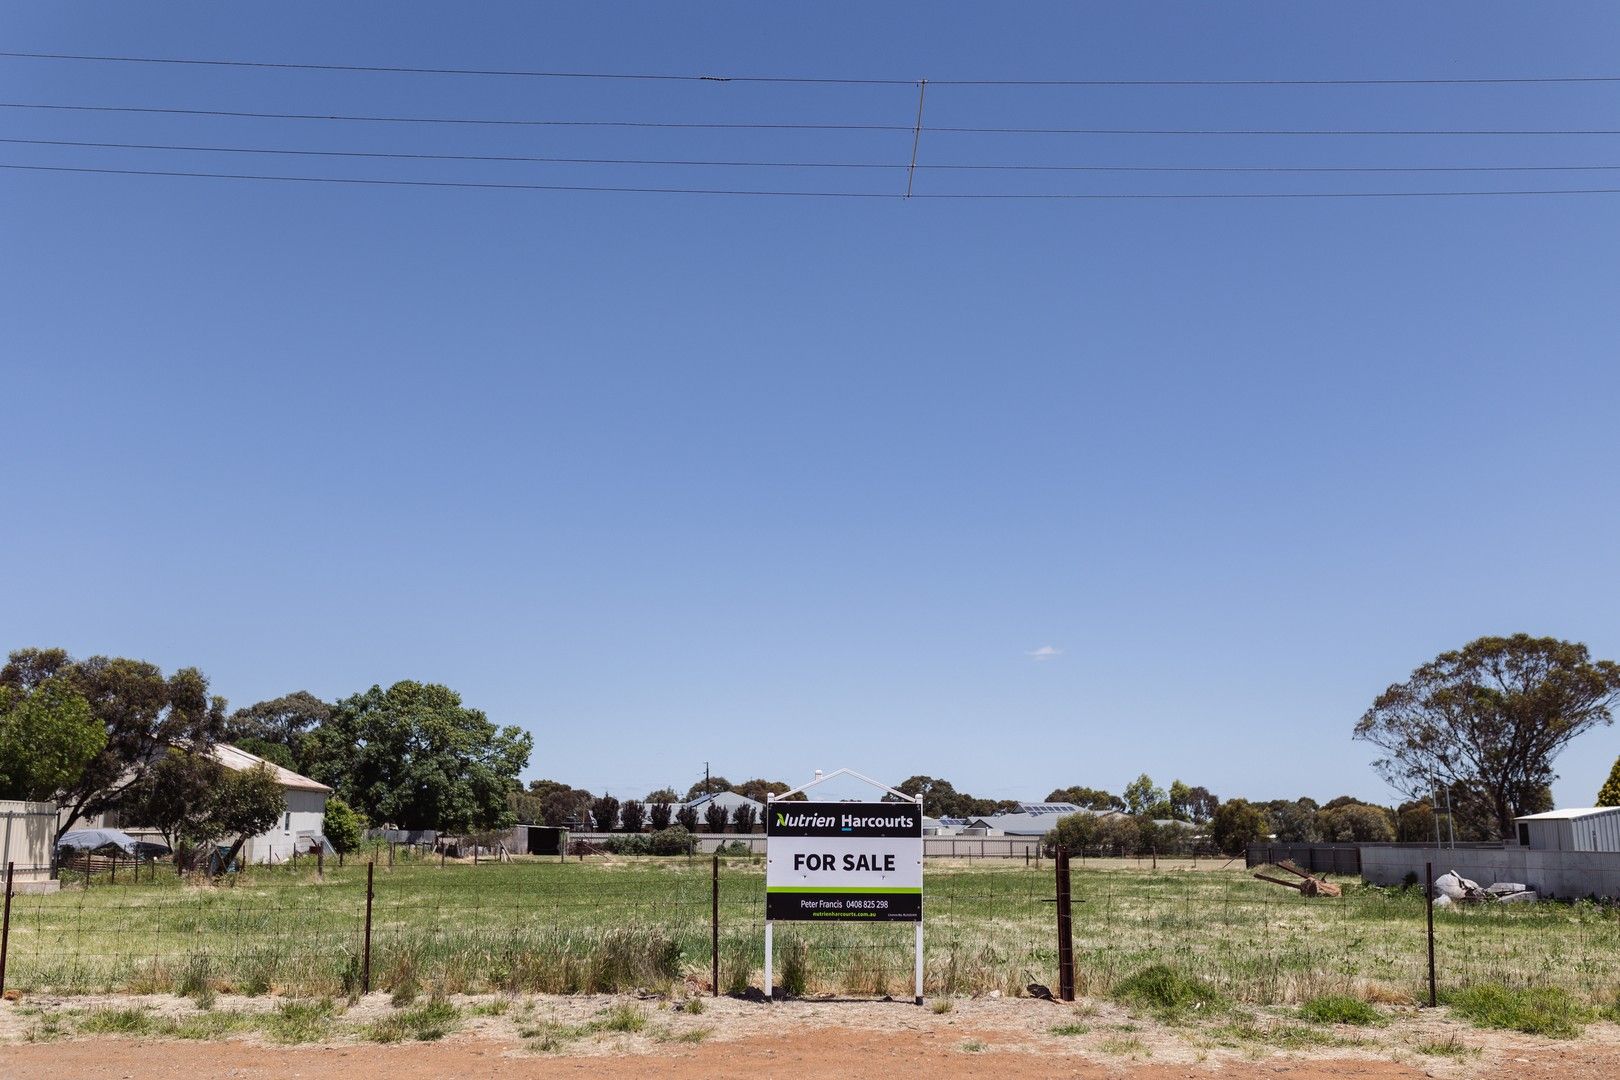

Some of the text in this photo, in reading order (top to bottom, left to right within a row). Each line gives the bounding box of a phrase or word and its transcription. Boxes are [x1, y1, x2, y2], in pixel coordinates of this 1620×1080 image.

[776, 812, 914, 828] Nutrien Harcourts
[793, 854, 896, 871] FOR SALE
[800, 900, 889, 909] Peter Francis 0408 825 298
